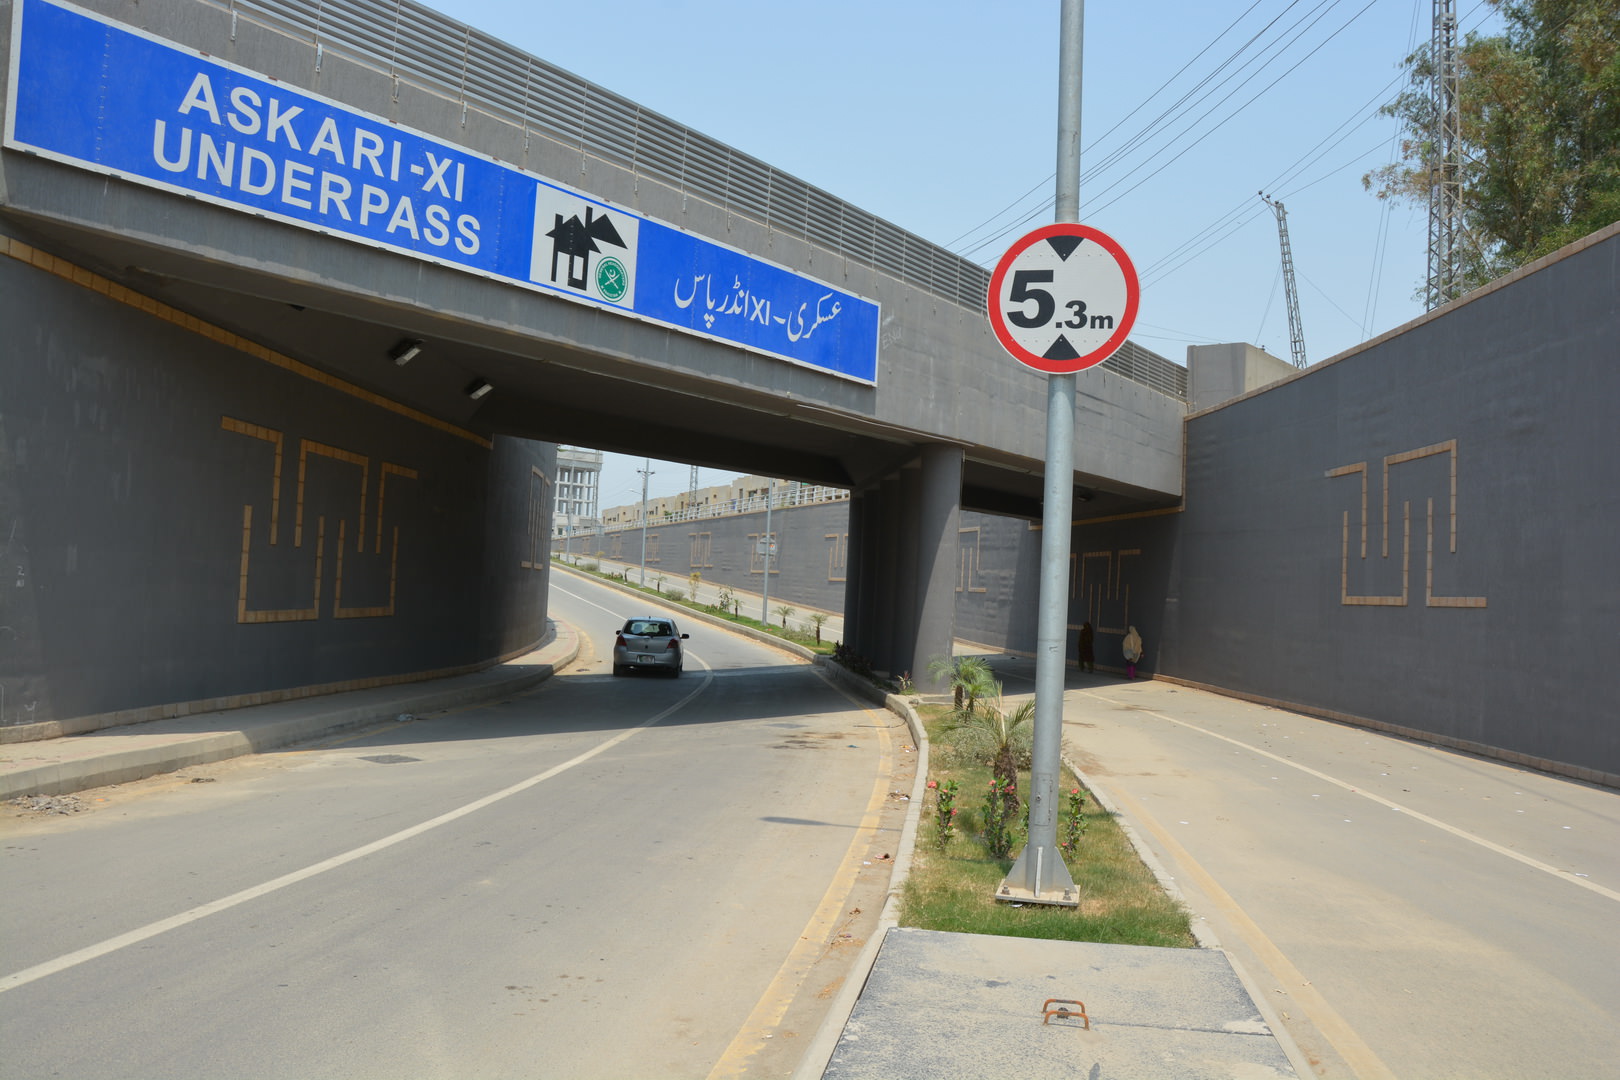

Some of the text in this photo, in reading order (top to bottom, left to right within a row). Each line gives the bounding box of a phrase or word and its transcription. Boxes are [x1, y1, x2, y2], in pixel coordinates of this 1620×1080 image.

[153, 119, 481, 255] UNDERPASS
[178, 73, 465, 202] ASKARI-XI
[1007, 270, 1114, 329] 5.3m
